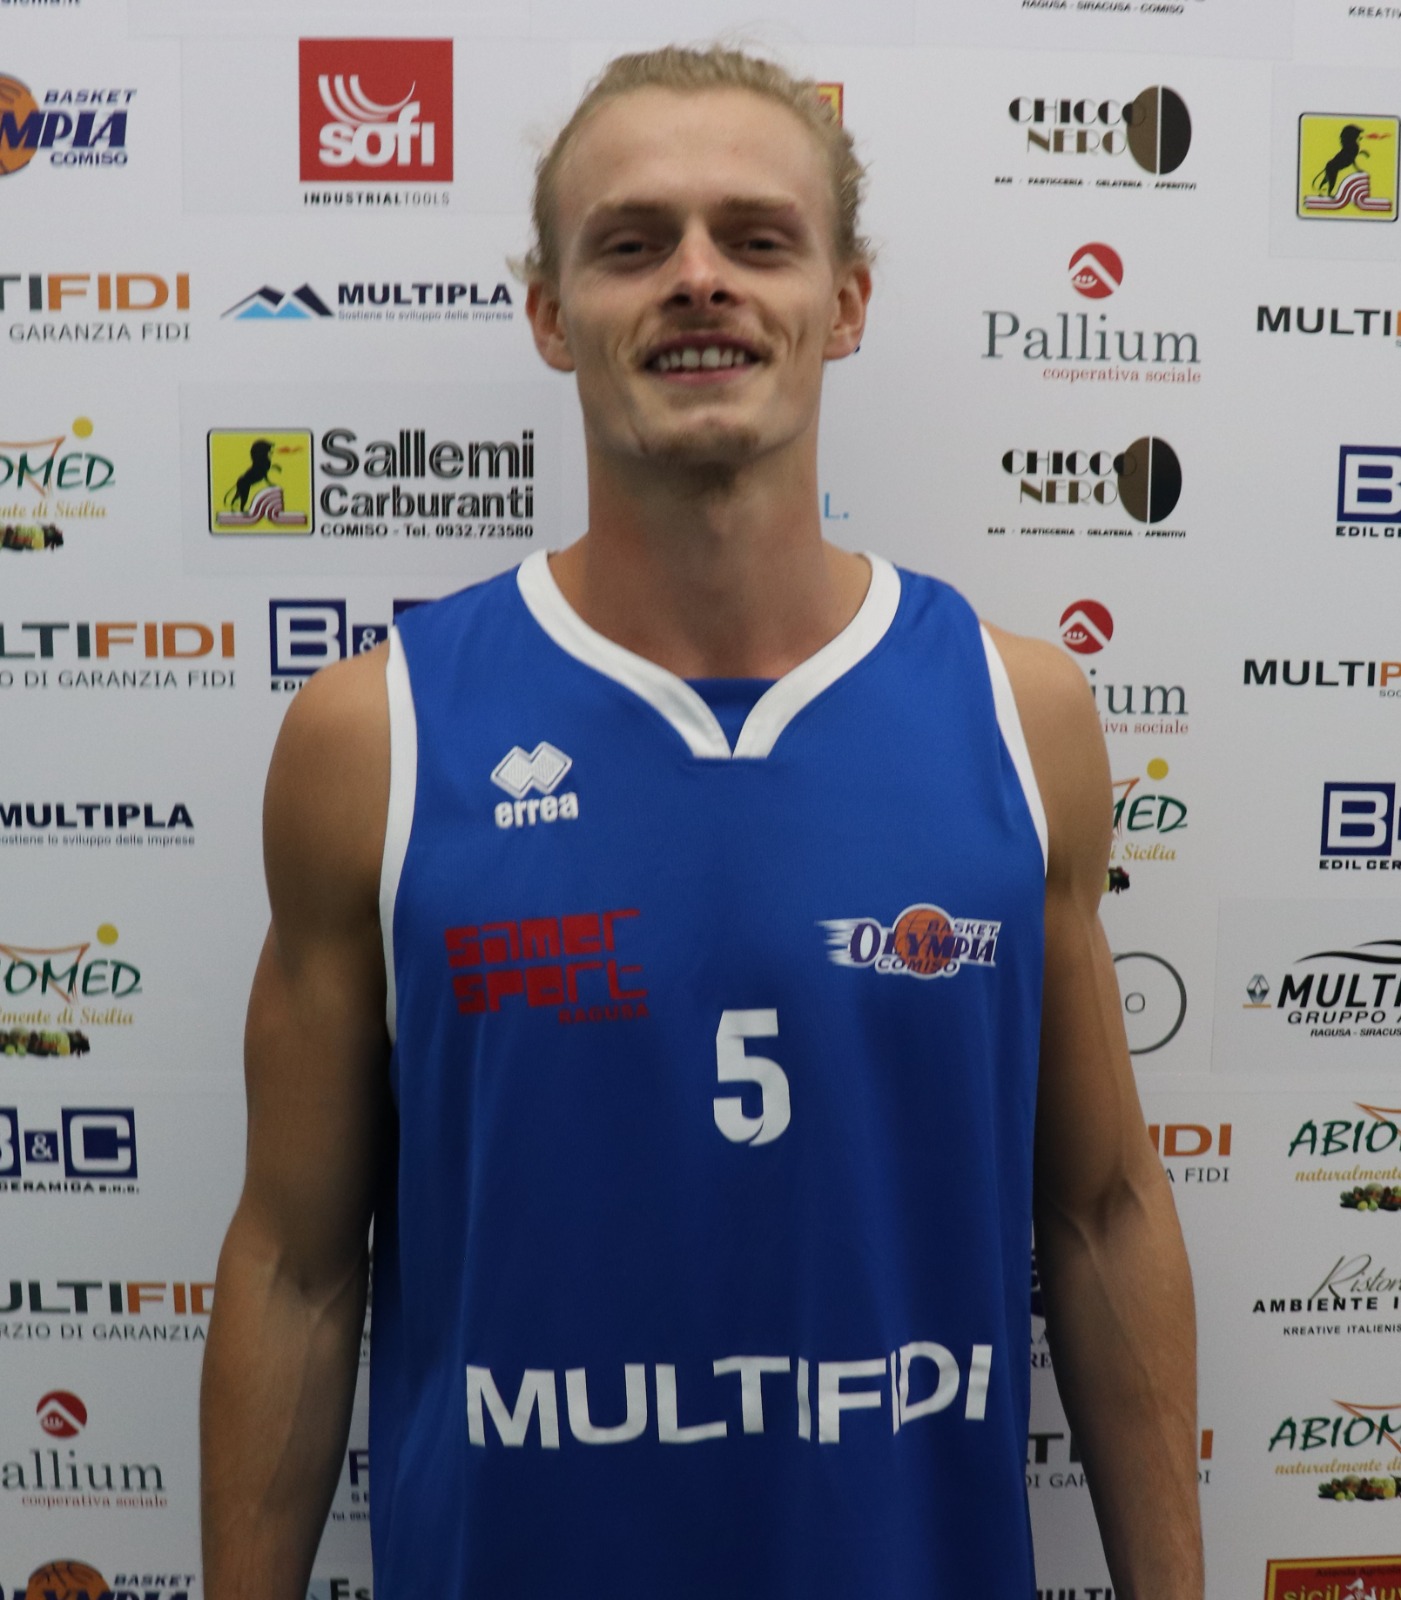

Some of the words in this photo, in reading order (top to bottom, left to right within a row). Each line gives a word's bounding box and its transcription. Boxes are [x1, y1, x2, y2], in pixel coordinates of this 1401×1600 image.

[44, 89, 137, 104] BASKET
[1027, 127, 1127, 157] NERO
[50, 151, 129, 167] COMISO
[337, 283, 513, 305] MULTIPLA
[1257, 305, 1401, 337] MULTI
[9, 323, 131, 342] GARANZIA
[142, 323, 191, 341] FIDI
[981, 310, 1201, 363] Pallium
[1042, 367, 1139, 382] cooperativa
[1146, 368, 1202, 382] sociale
[320, 429, 534, 478] Sallemi
[1019, 478, 1118, 505] NERO
[320, 484, 534, 519] Carburanti
[320, 522, 388, 538] COMISO
[435, 522, 534, 538] 0932.723580
[988, 526, 1006, 535] BAR
[24, 671, 48, 688] DI
[58, 671, 178, 688] GARANZIA
[187, 671, 235, 687] FIDI
[1134, 720, 1189, 734] sociale
[0, 802, 194, 829] MULTIPLA
[494, 792, 579, 829] errea
[0, 833, 44, 845] ostiene
[62, 833, 111, 848] sviluppo
[115, 833, 143, 845] delle
[147, 833, 195, 848] imprese
[1122, 842, 1177, 861] Sicilia
[57, 1007, 73, 1025] di
[80, 1007, 134, 1025] Sicilia
[1287, 1010, 1386, 1025] GRUPPO
[1310, 1027, 1351, 1037] RAGUSA
[713, 1008, 791, 1147] 5
[1185, 1167, 1230, 1183] FIDI
[1253, 1297, 1378, 1313] AMBIENTE
[60, 1323, 83, 1339] DI
[93, 1323, 205, 1341] GARANZIA
[1283, 1326, 1341, 1336] KREATIVE
[466, 1341, 993, 1450] MULTIFIDI
[1274, 1457, 1382, 1475] naturalmente
[22, 1493, 110, 1510] cooperativa
[117, 1493, 167, 1508] sociale
[114, 1574, 196, 1588] BASKET
